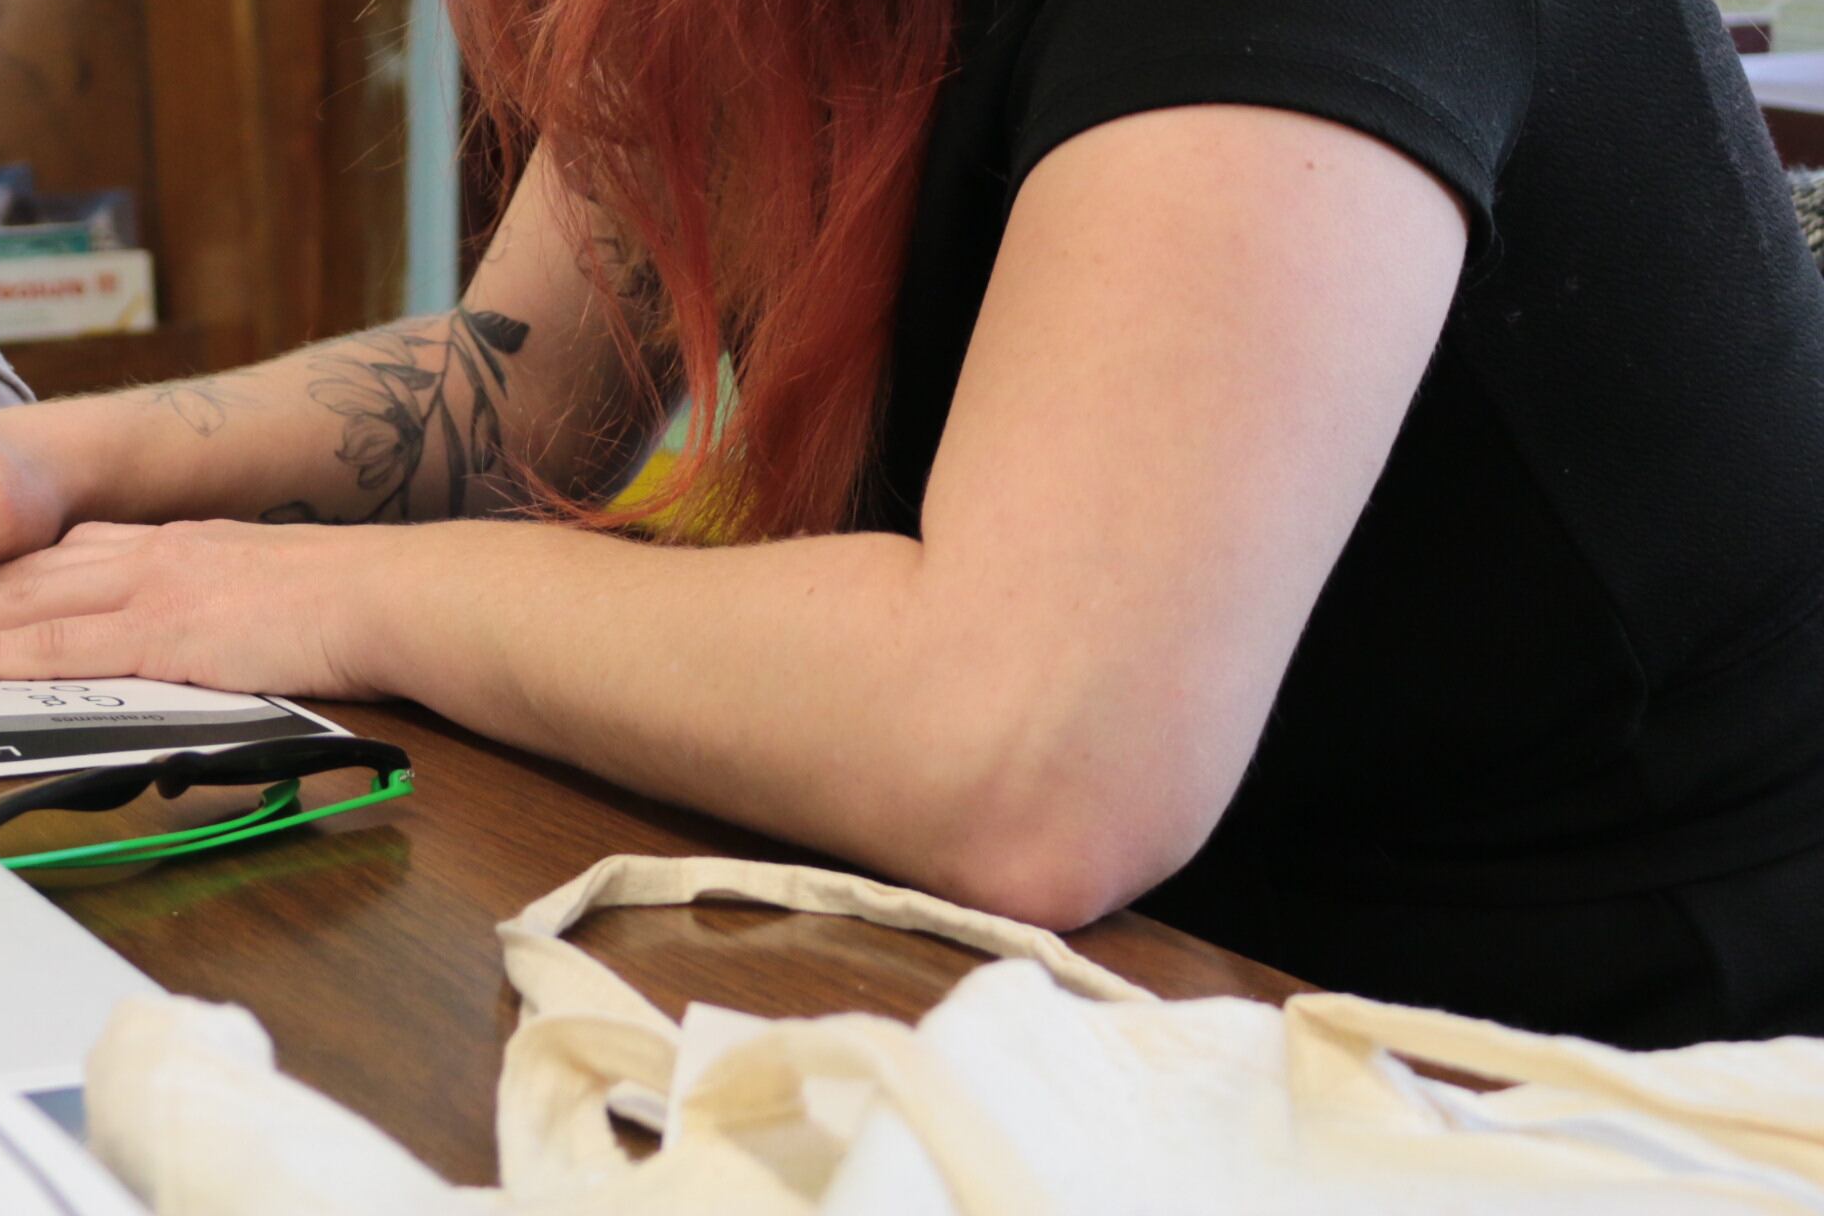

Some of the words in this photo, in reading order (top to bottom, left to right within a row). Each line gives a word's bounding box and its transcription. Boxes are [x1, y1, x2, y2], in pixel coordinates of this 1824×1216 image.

[27, 694, 67, 707] g
[79, 695, 125, 707] G
[50, 713, 166, 724] Graphemes
